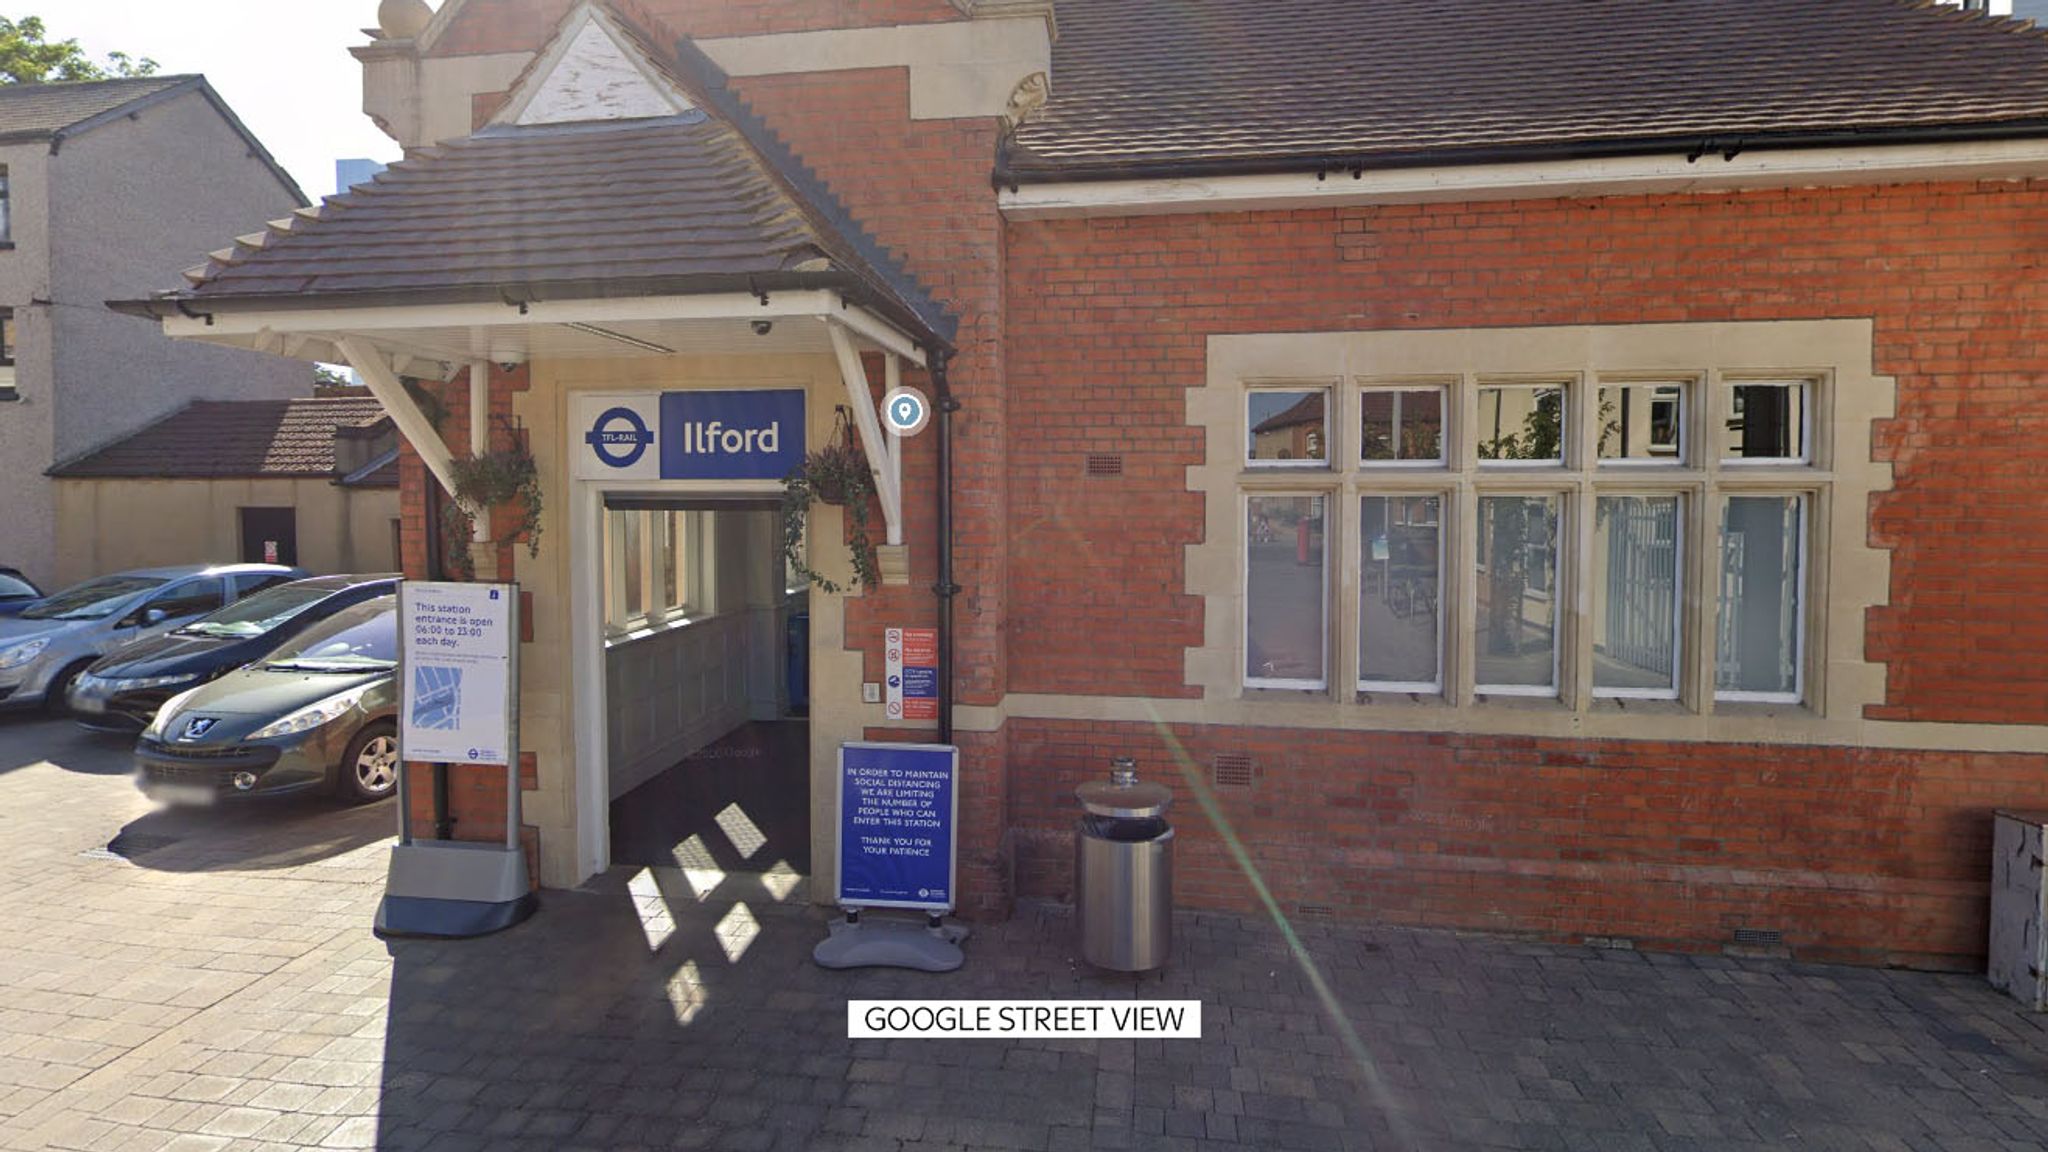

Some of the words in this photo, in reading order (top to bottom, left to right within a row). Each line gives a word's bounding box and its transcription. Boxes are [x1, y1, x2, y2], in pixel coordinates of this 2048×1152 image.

[601, 433, 638, 442] TFL-RAIL
[684, 421, 779, 453] Ilford
[416, 602, 435, 612] This
[438, 604, 471, 613] station
[415, 616, 457, 624] entrance
[460, 616, 467, 624] is
[415, 625, 441, 634] 06:00
[445, 627, 455, 635] to
[415, 637, 438, 645] each
[440, 638, 460, 648] day.
[859, 768, 888, 777] ORDER
[905, 771, 948, 779] MAINTAIN
[854, 778, 885, 786] SOCIAL
[888, 779, 941, 789] DISTANCING
[861, 788, 875, 796] WE
[877, 789, 893, 797] ARE
[896, 790, 934, 798] LIMITING
[882, 799, 917, 807] NUMBER
[921, 800, 932, 808] OF
[858, 807, 889, 816] PEOPLE
[892, 809, 914, 817] WHO
[853, 816, 880, 825] ENTER
[905, 819, 940, 827] STATION
[863, 846, 887, 854] YOUR
[890, 847, 929, 856] PATIENCE
